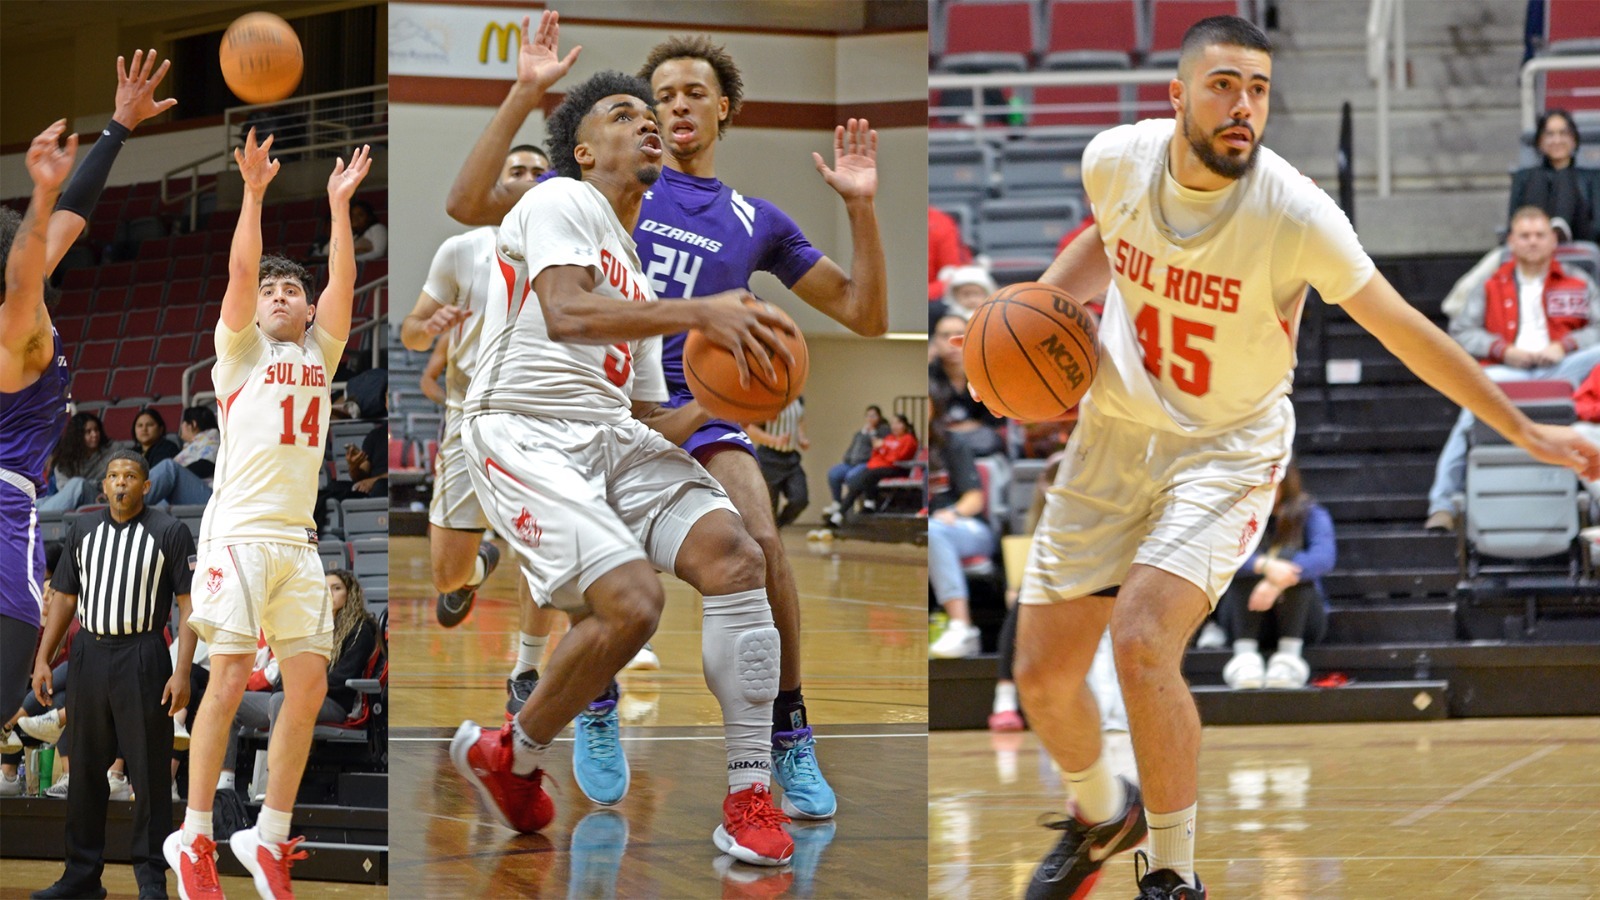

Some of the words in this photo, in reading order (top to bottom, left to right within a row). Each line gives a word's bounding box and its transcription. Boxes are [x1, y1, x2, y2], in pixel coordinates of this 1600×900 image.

[639, 219, 723, 253] OZARKS
[600, 248, 629, 299] SUL
[646, 242, 703, 300] 24
[1115, 238, 1155, 293] SUL
[1163, 264, 1242, 313] ROSS
[264, 362, 296, 385] SUL
[300, 364, 326, 387] ROS
[1040, 333, 1085, 391] NCAA
[1133, 302, 1216, 398] 45
[280, 394, 320, 448] 14
[728, 760, 771, 770] ARMO
